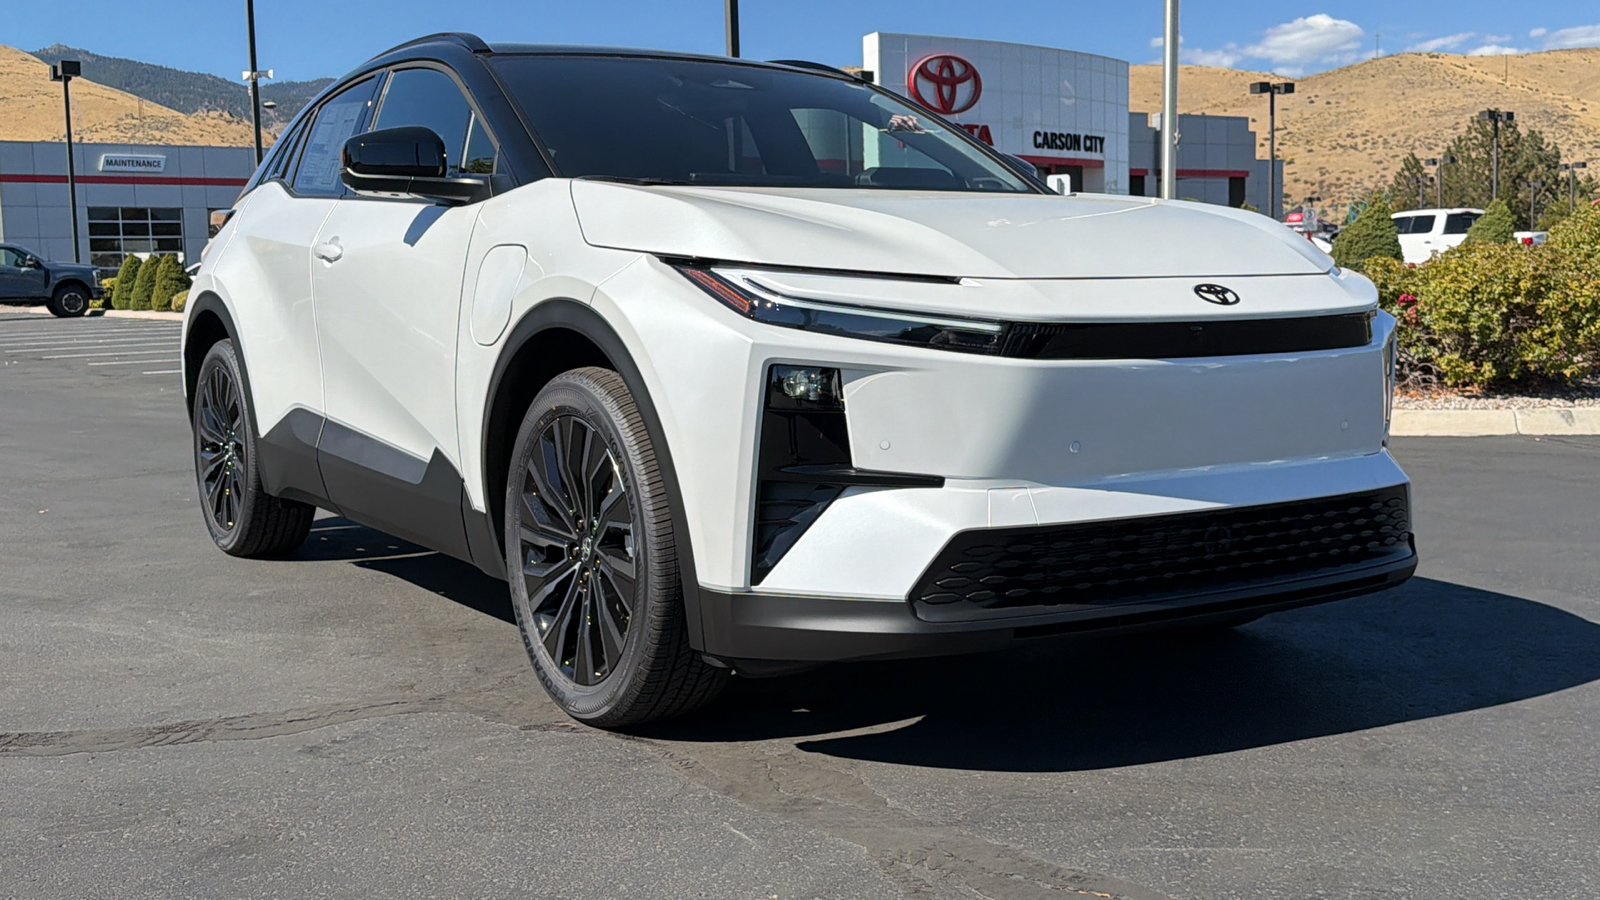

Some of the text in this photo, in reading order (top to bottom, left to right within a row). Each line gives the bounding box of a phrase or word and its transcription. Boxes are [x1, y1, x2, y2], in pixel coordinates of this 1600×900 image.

[1033, 131, 1105, 153] CARSON CITY
[106, 159, 162, 168] MAINTENANCE
